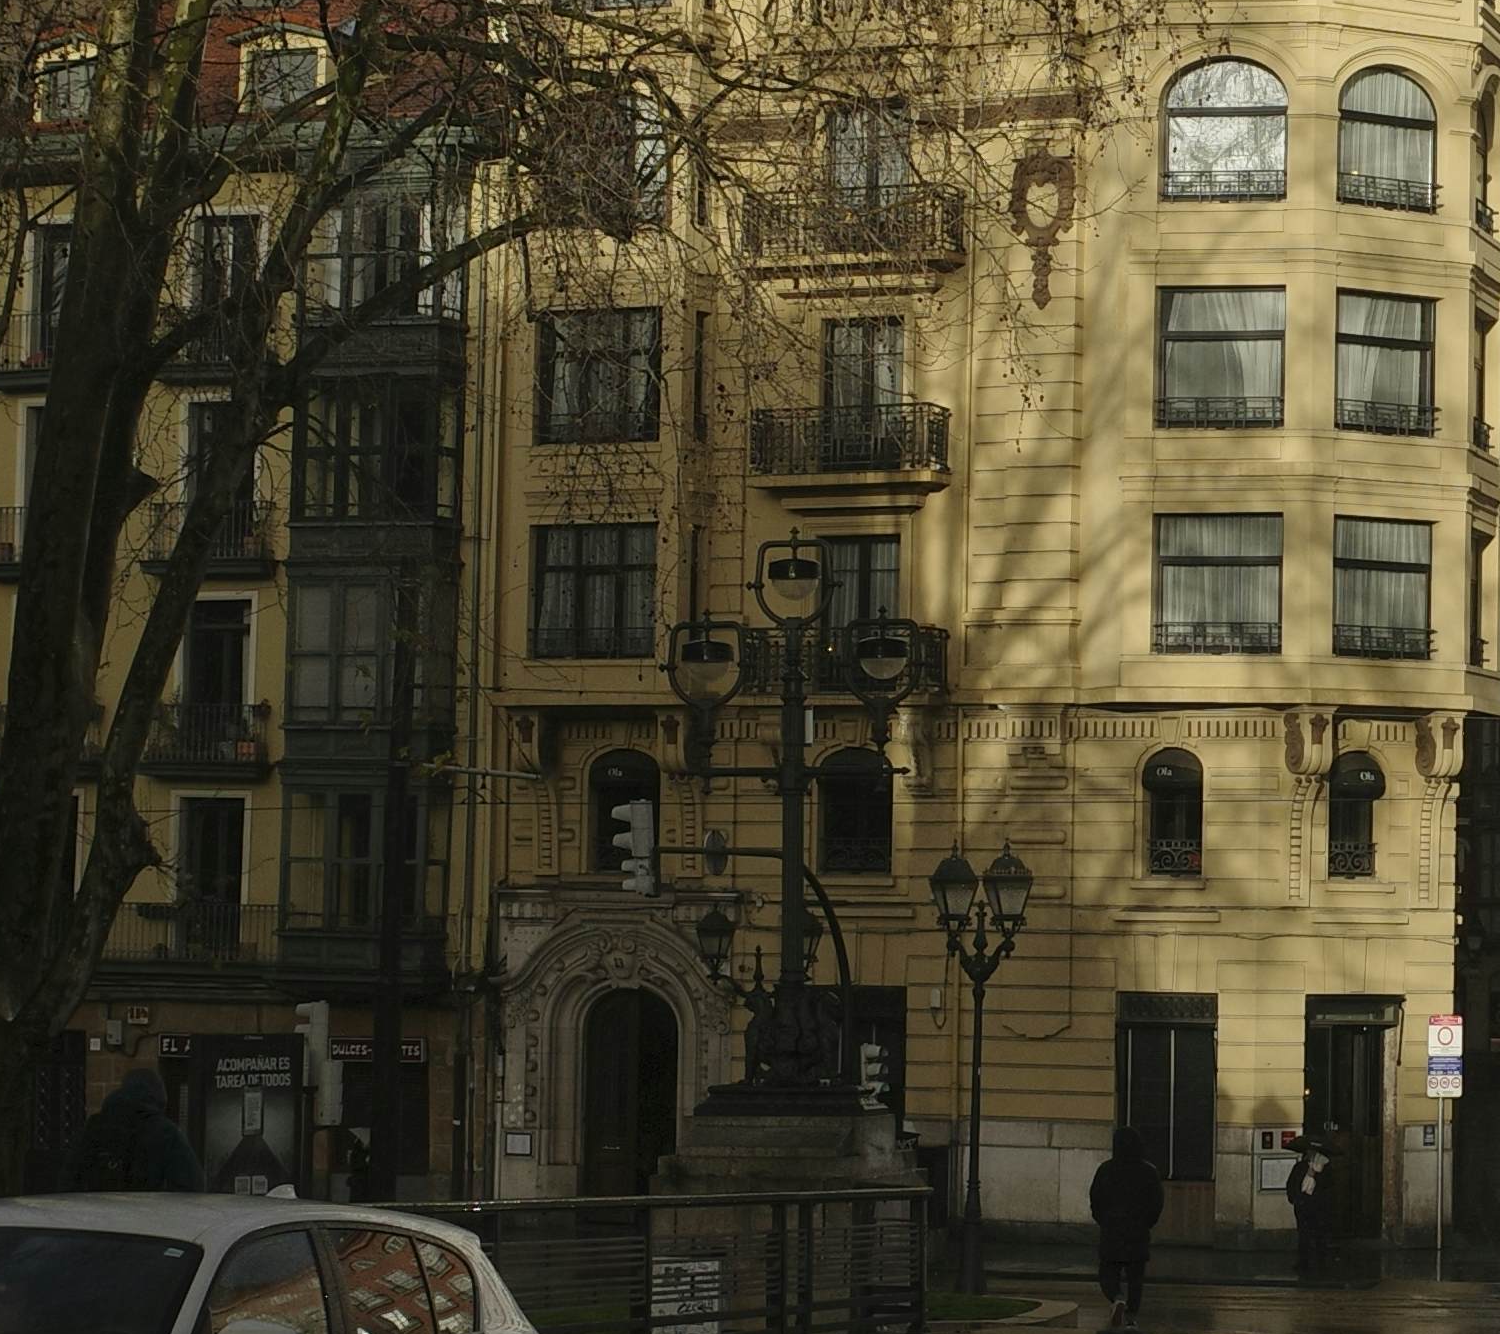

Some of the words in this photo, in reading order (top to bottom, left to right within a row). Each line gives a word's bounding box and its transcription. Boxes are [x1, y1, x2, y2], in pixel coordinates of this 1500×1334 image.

[1360, 770, 1376, 781] Ola
[162, 1037, 178, 1052] EL
[279, 1056, 290, 1070] ES
[215, 1075, 245, 1088] TAREA
[261, 1073, 291, 1087] TODOS
